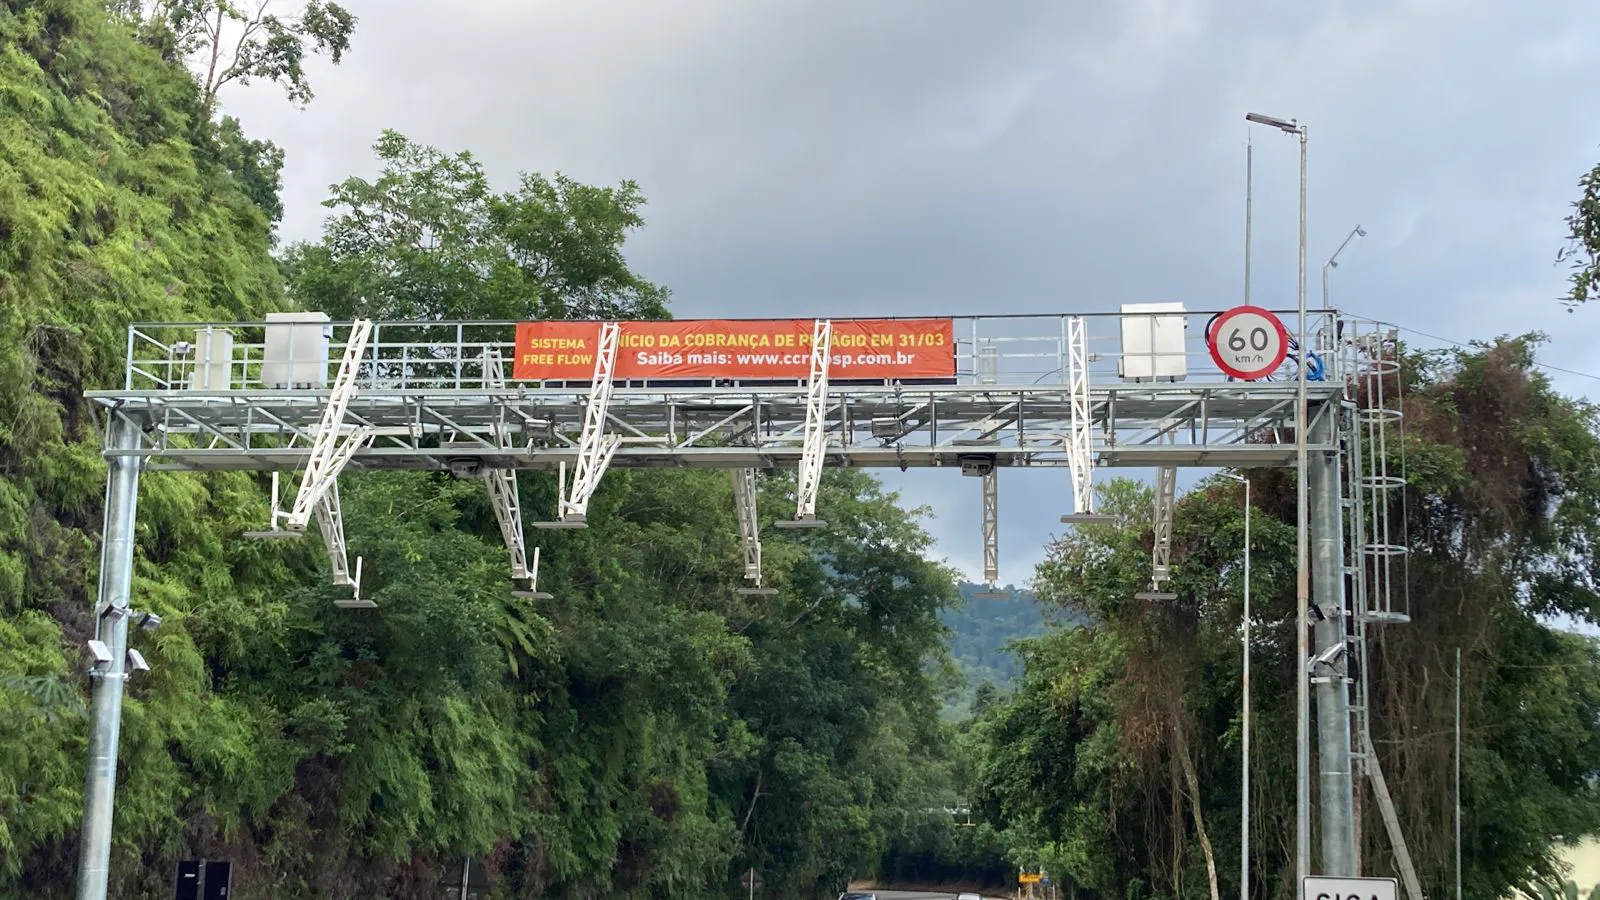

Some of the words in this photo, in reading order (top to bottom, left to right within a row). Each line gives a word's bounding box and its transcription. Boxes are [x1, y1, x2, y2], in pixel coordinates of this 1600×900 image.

[531, 338, 585, 349] SISTEMA
[617, 333, 655, 348] NÍCIO
[659, 335, 680, 347] DA
[684, 333, 770, 349] COBRANÇA
[774, 334, 794, 347] DE
[871, 334, 893, 347] EM
[899, 333, 944, 347] 31/03
[1228, 327, 1268, 351] 60
[523, 354, 553, 365] FREE
[557, 354, 592, 365] FLOW
[637, 351, 682, 365] Saiba
[687, 351, 732, 365] mais:
[737, 351, 915, 368] www.ccrsp.com.br
[1235, 354, 1263, 363] km/h
